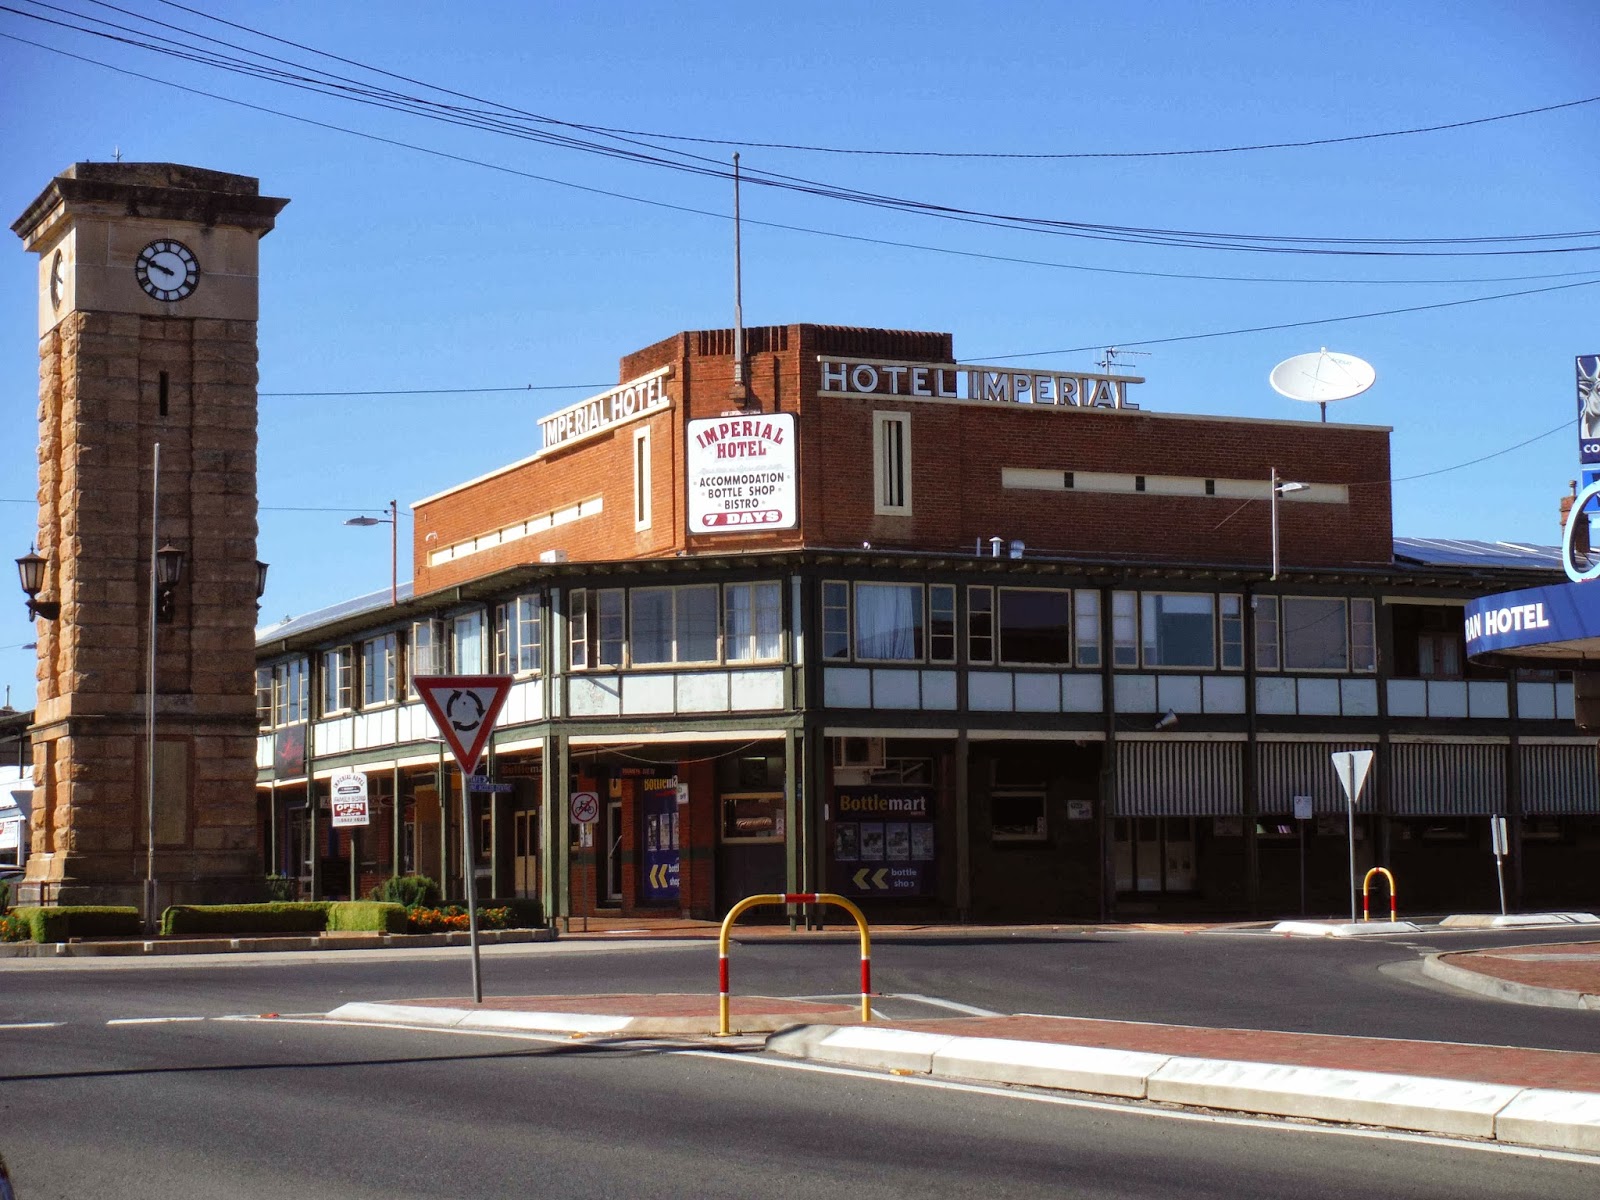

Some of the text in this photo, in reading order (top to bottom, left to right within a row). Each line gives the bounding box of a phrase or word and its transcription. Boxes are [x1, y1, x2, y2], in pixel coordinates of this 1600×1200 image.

[823, 361, 1140, 410] HOTEL IMPERIAL
[542, 376, 668, 449] IMPERIAL HOTEL
[696, 420, 784, 449] IMPERIAL
[717, 440, 767, 459] HOTEL
[699, 472, 785, 488] ACCOMMODATION
[708, 484, 775, 499] BOTTLE SHOP
[724, 498, 759, 510] BISTRO
[705, 510, 779, 526] 7 DAYS
[1485, 602, 1550, 636] HOTEL
[336, 803, 363, 811] OPEN
[840, 794, 926, 811] Bottlemart
[891, 868, 917, 876] bottle
